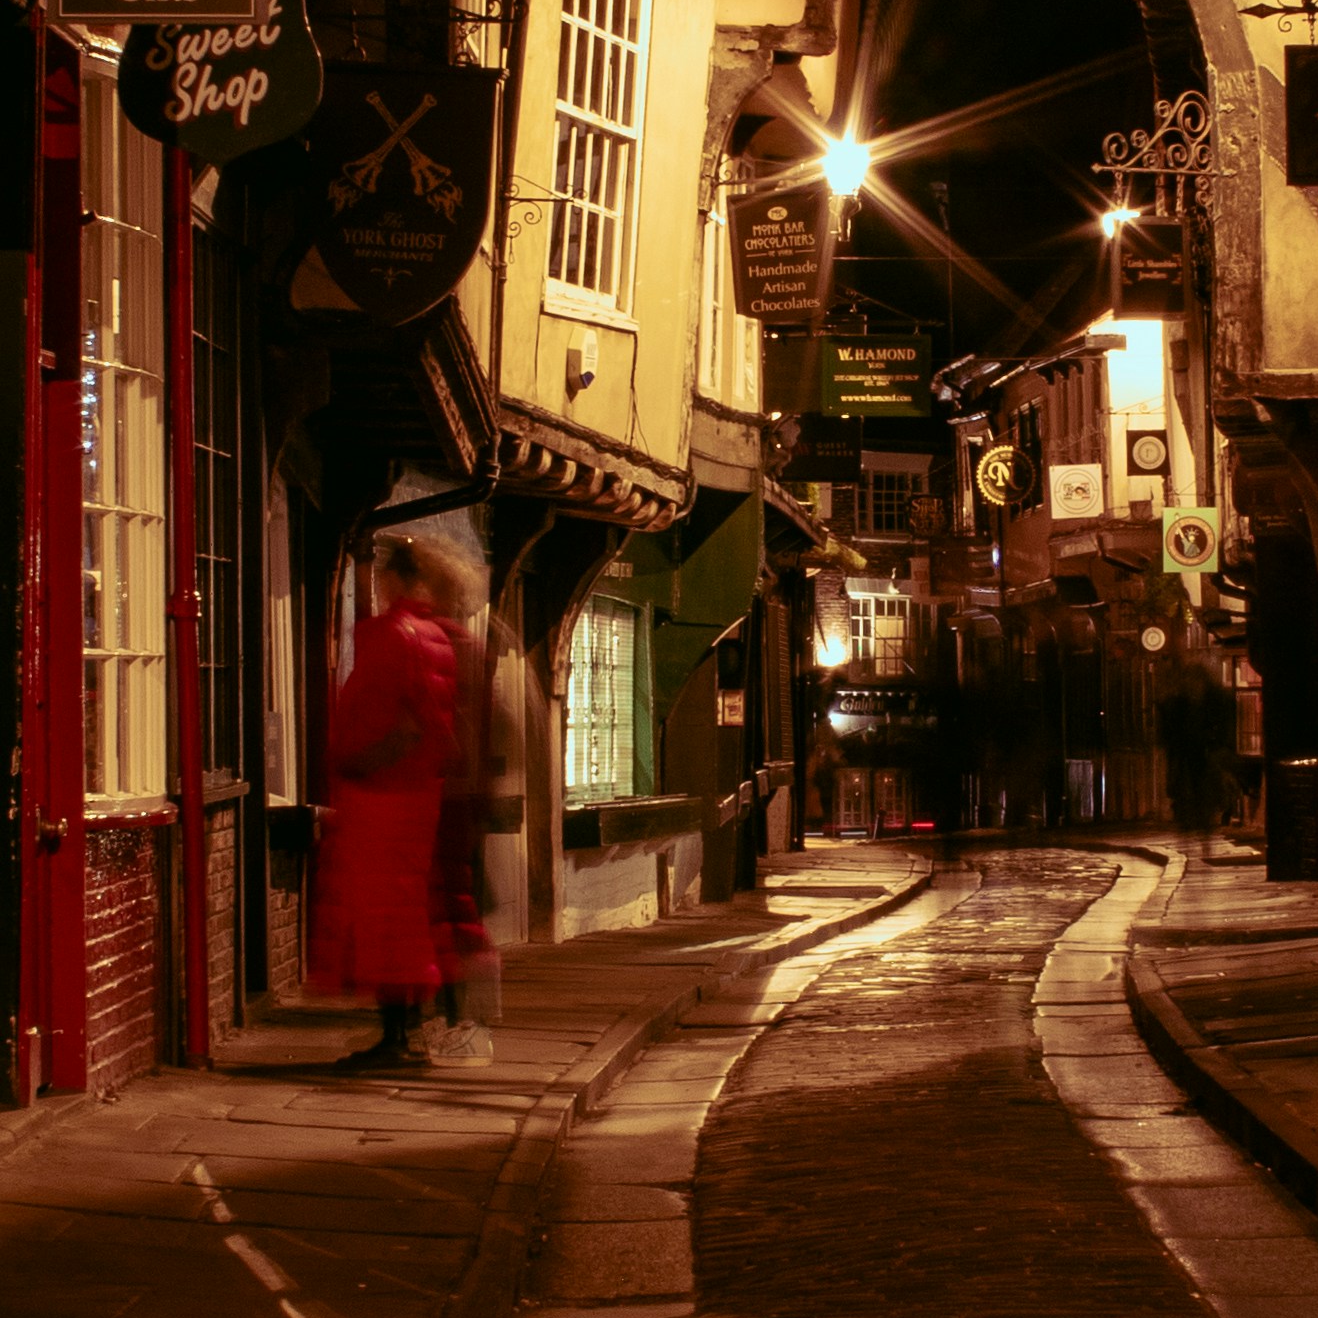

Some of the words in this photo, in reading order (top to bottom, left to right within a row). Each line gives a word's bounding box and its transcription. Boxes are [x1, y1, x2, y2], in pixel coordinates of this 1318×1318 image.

[164, 62, 269, 126] Shop
[752, 223, 782, 237] MONK
[784, 221, 806, 235] BAR
[342, 228, 387, 247] YORK
[390, 231, 447, 251] GHOST
[744, 233, 816, 251] CHOCOLATIERS
[352, 248, 435, 263] MERCHANTS
[748, 259, 818, 278] Handmade
[762, 280, 807, 295] Artisan
[750, 296, 821, 313] Chocolates
[855, 348, 917, 361] HAMOND
